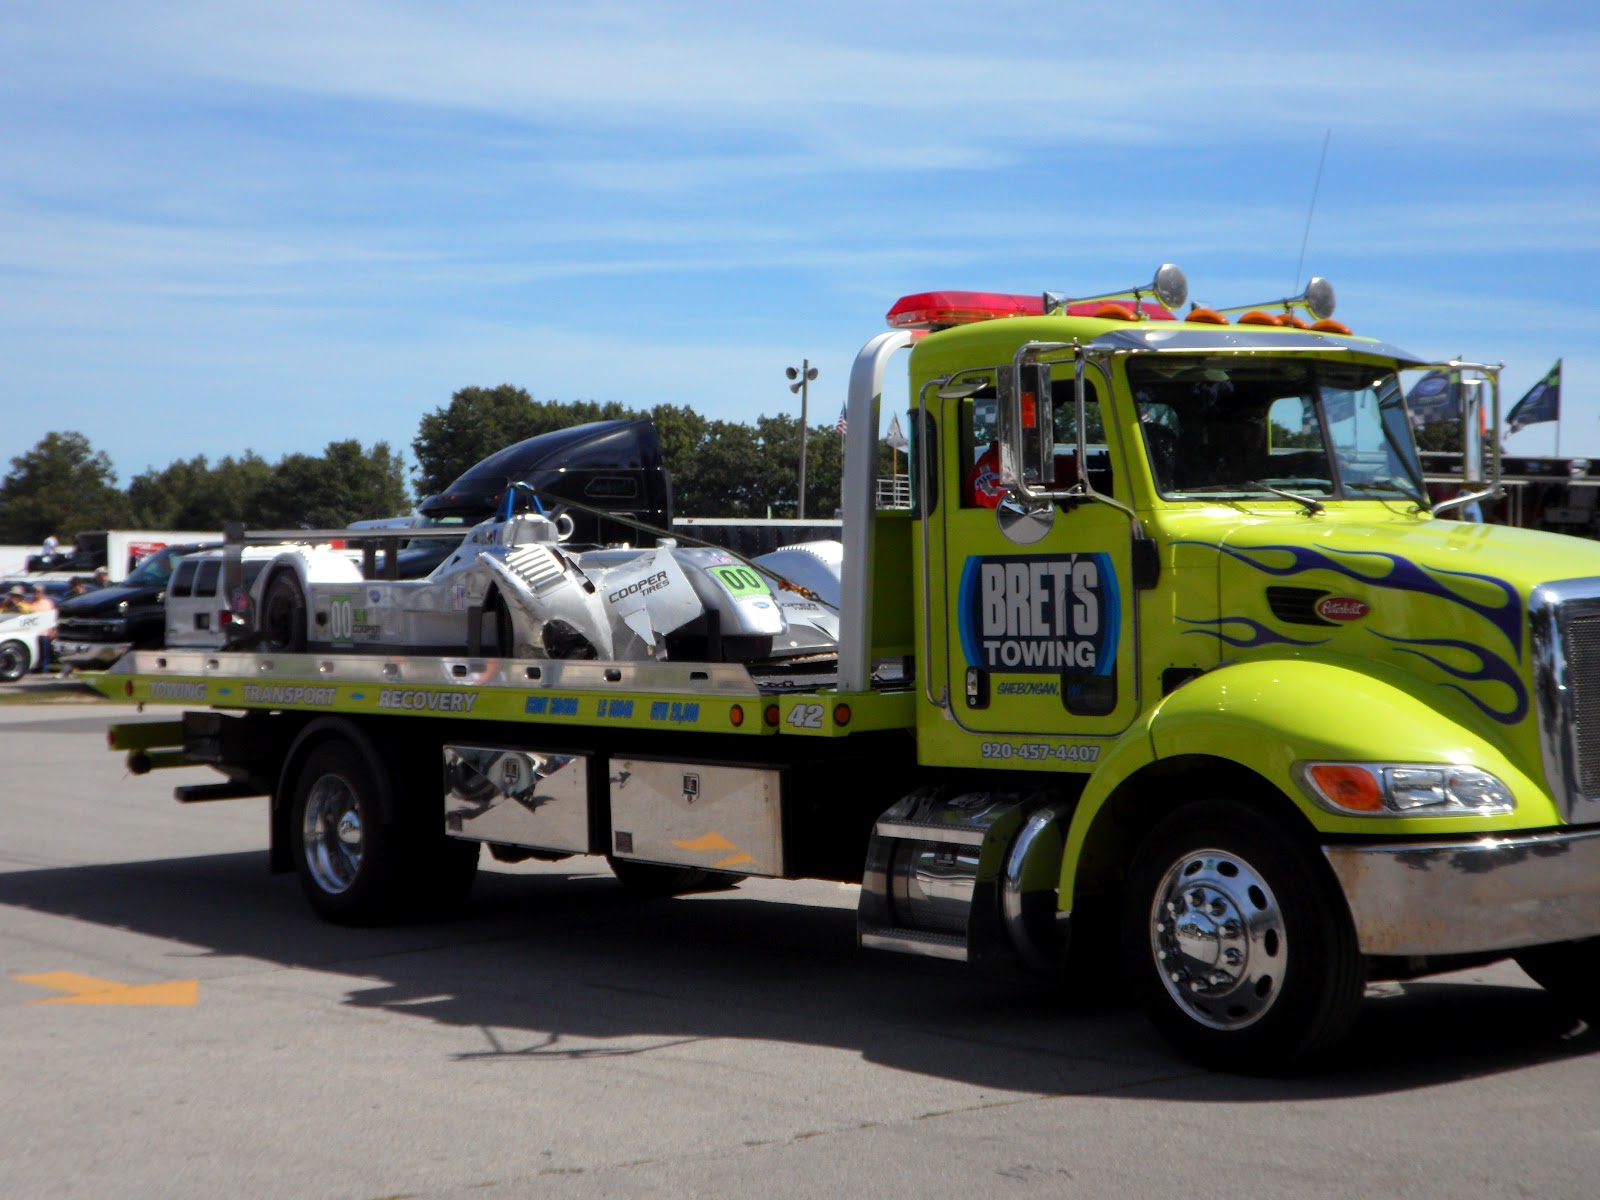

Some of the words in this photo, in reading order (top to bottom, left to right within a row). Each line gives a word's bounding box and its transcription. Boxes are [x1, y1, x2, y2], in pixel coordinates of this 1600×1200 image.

[608, 570, 668, 604] COOPER
[640, 578, 670, 597] TIRES
[720, 568, 761, 590] 00
[981, 553, 1099, 637] BRET'S
[1322, 600, 1365, 615] Peterbilt
[982, 640, 1096, 668] TOWING
[150, 681, 205, 699] TOWING
[242, 684, 336, 706] TRANSPORT
[378, 689, 478, 712] RECOVERY
[786, 703, 824, 729] 42
[981, 741, 1101, 763] 920-457-4407
